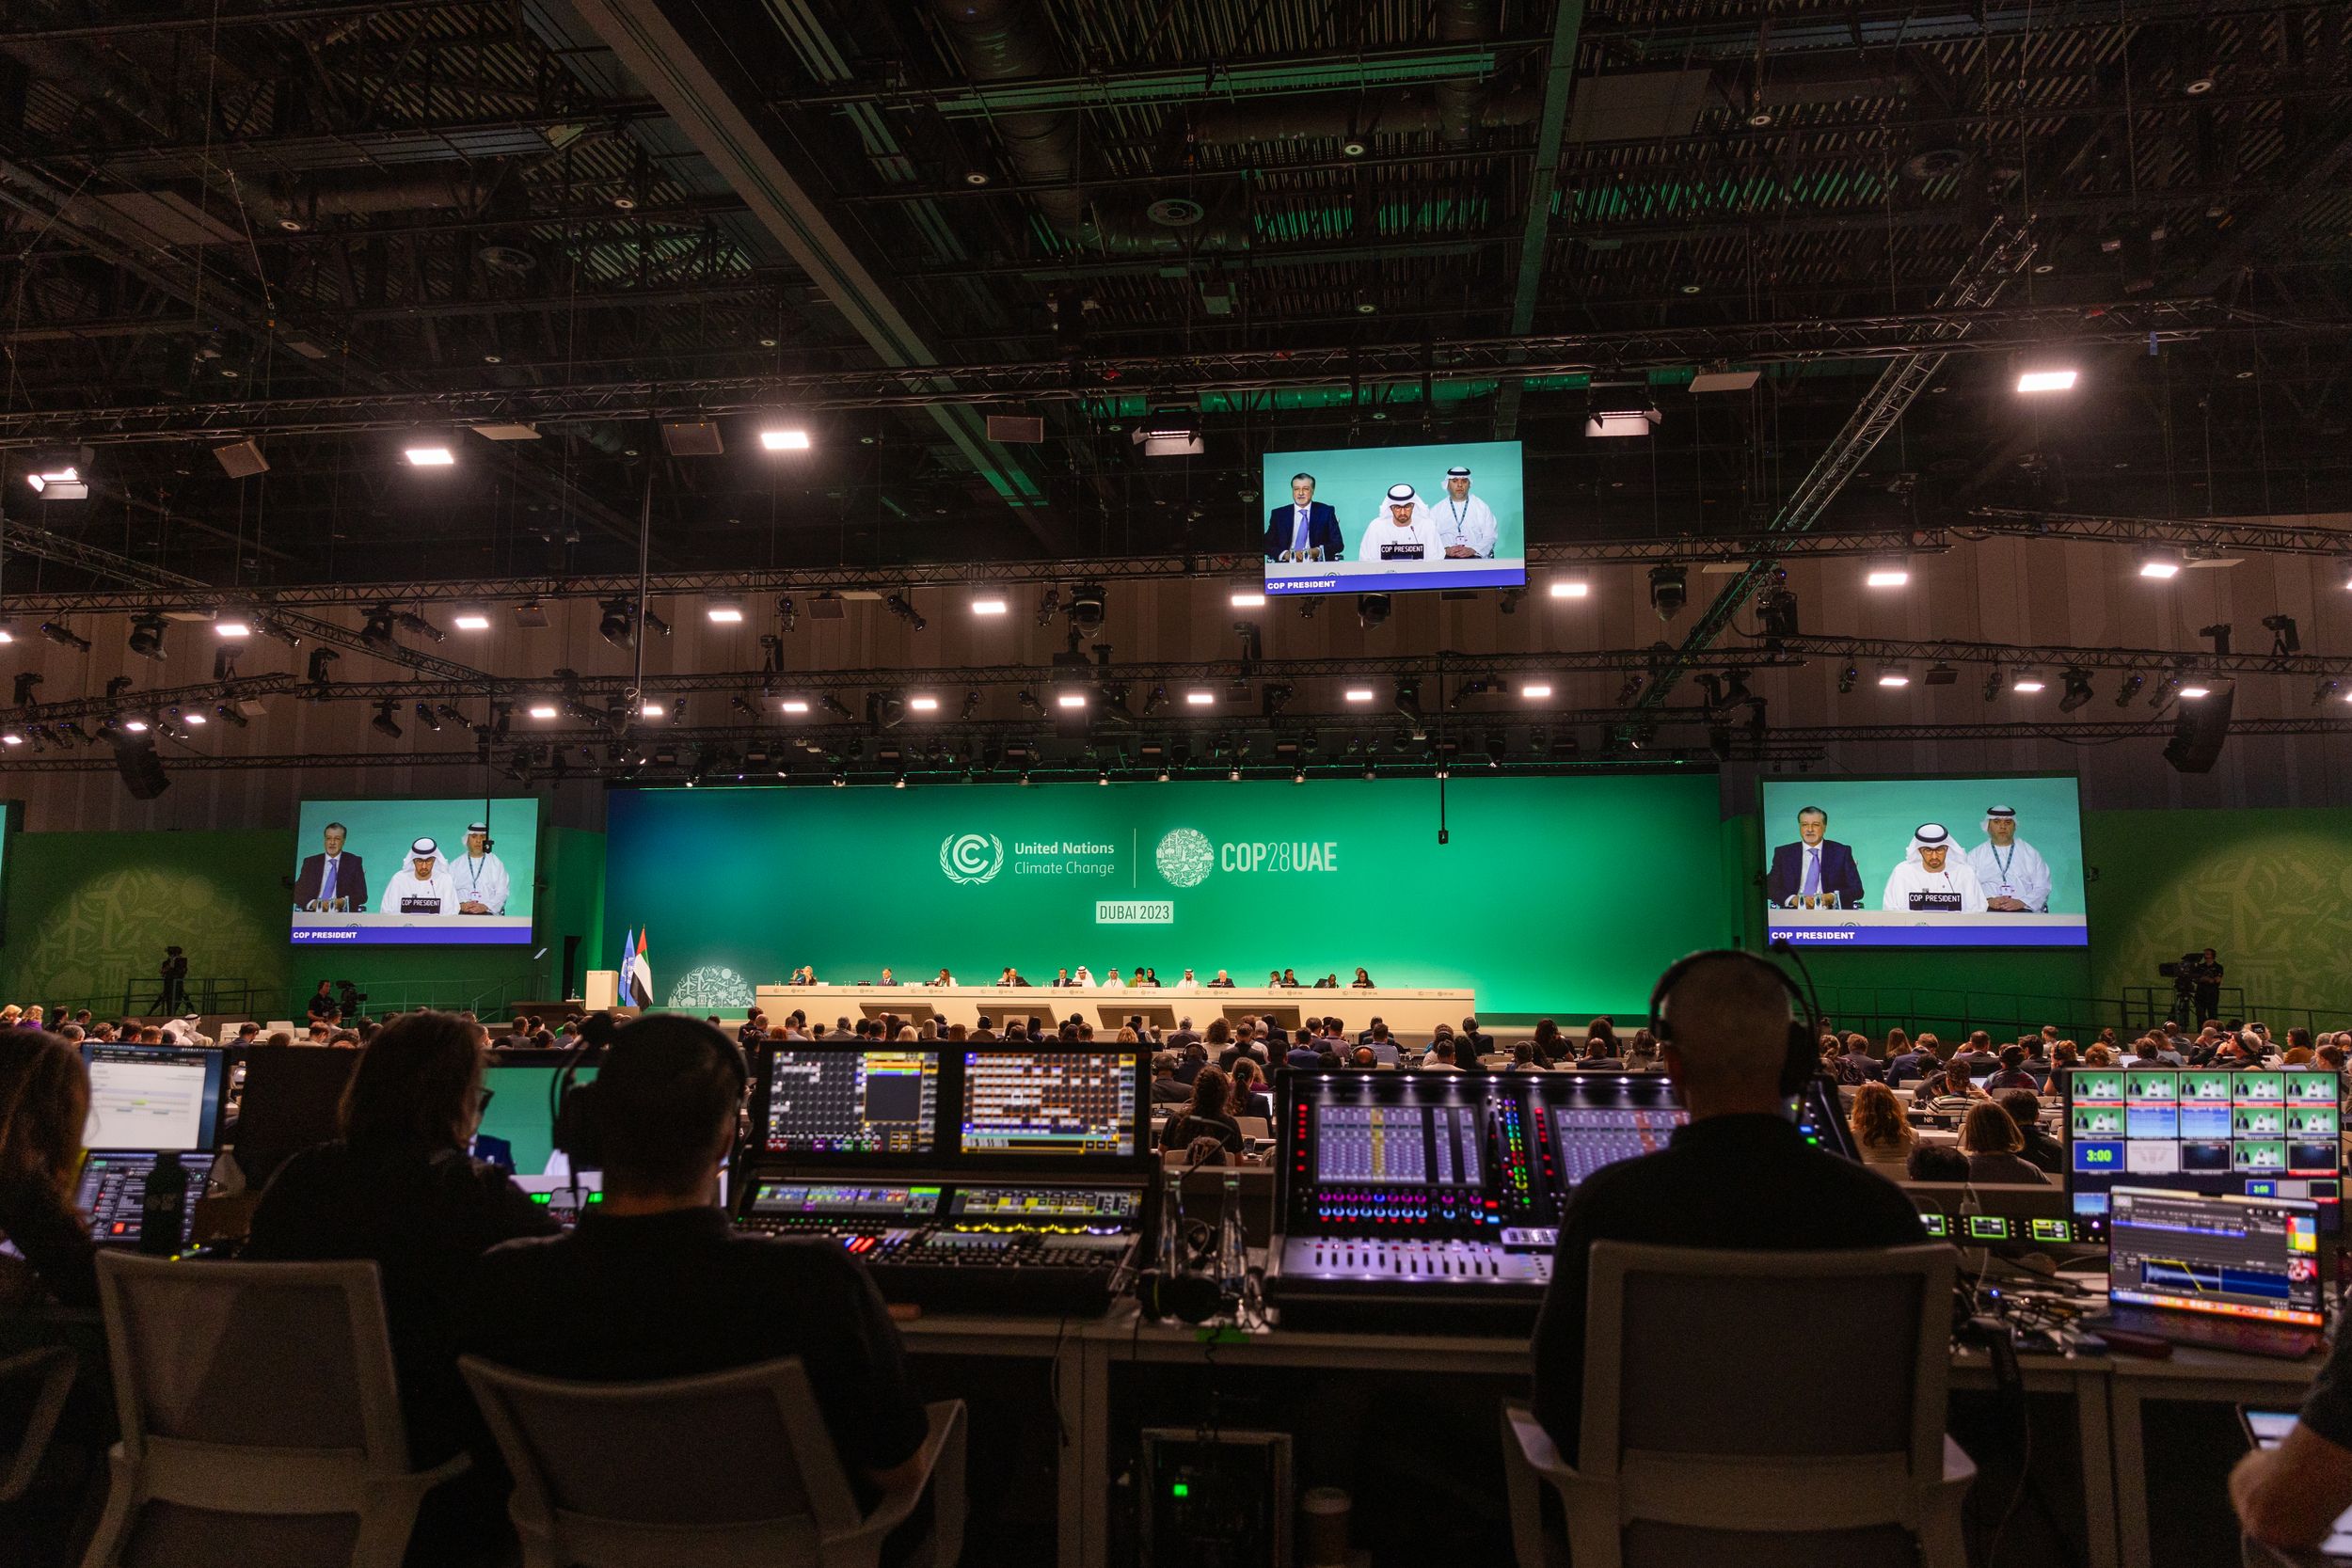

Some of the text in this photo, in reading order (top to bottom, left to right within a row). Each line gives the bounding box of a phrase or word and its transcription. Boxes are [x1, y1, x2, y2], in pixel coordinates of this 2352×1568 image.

[1287, 580, 1336, 589] PRESIDENT
[1014, 841, 1115, 854] United Nations
[1014, 861, 1115, 877] Climate Change
[1909, 894, 1961, 903] COP PRESIDENT
[1100, 905, 1169, 920] DUBAI 2023
[1772, 931, 1855, 940] COP PRESIDENT
[2086, 1149, 2113, 1163] 3:00
